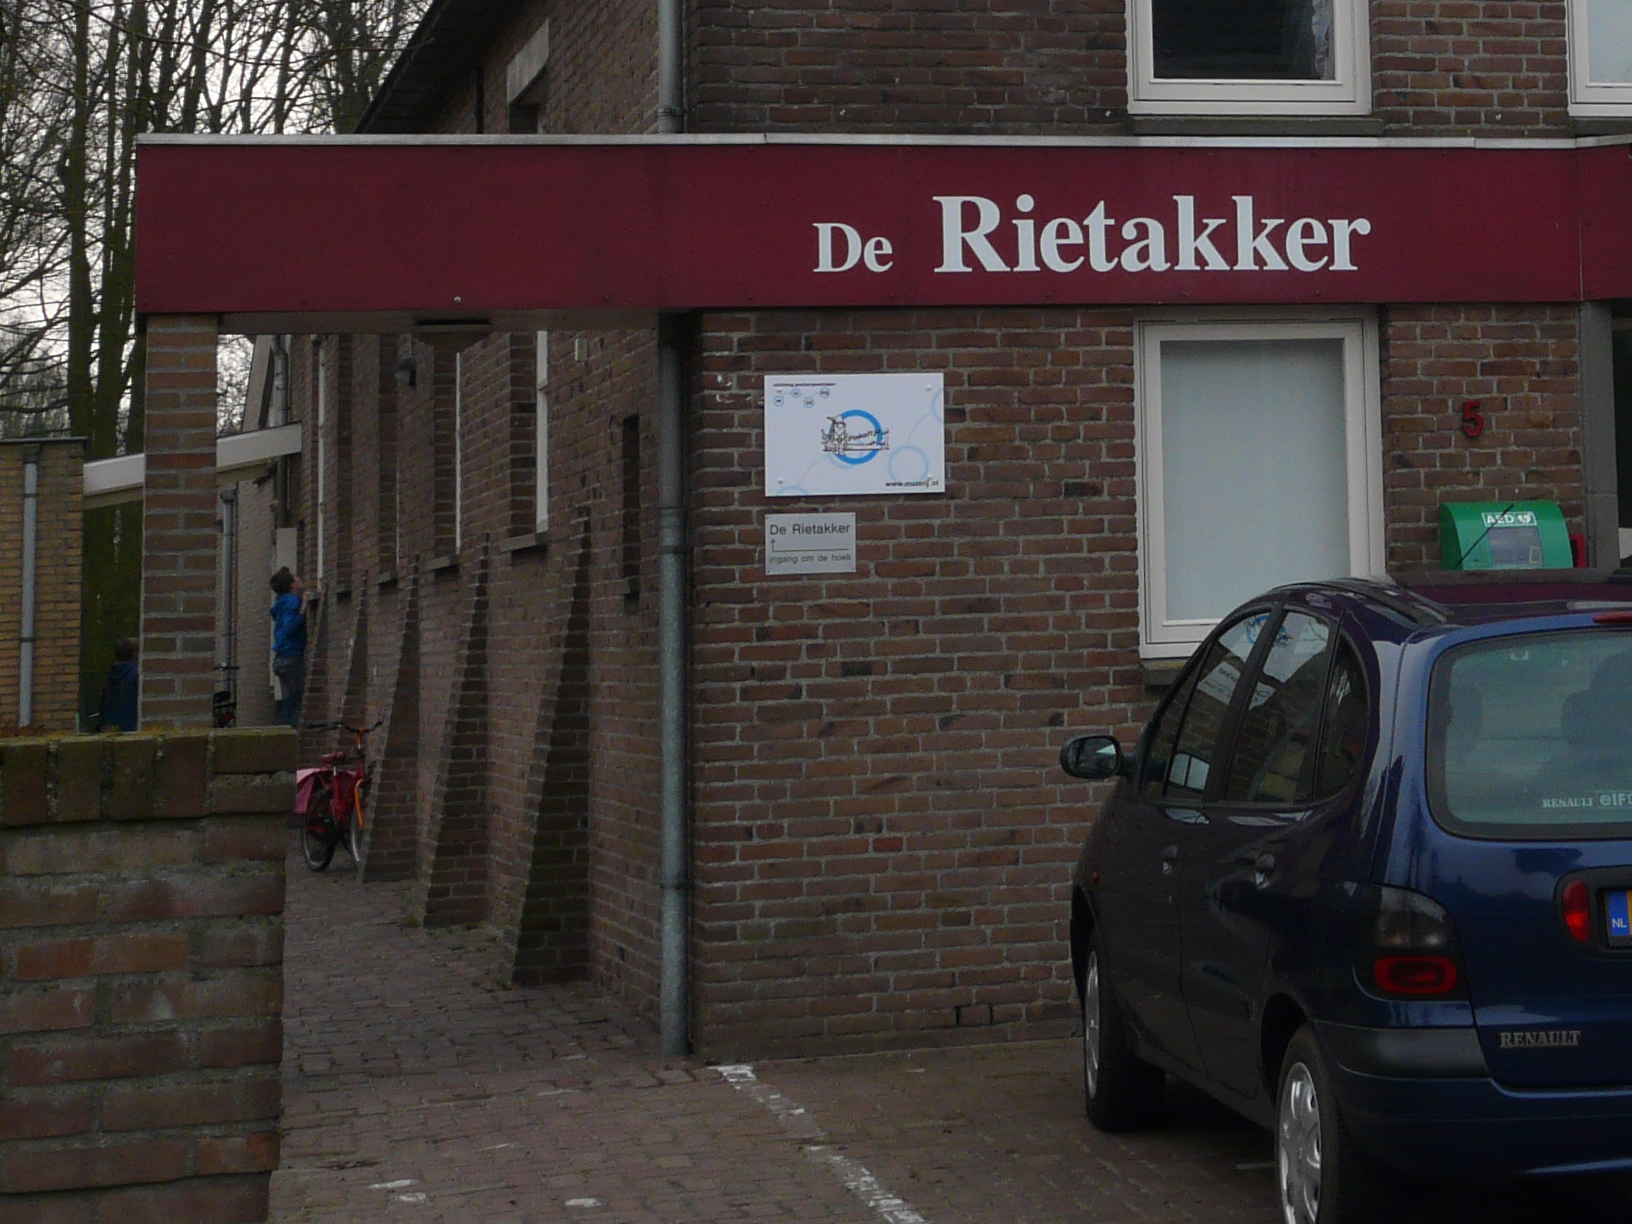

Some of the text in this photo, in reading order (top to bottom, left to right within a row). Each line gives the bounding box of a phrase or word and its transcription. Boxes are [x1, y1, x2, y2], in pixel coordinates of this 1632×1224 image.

[811, 193, 1372, 273] De Rietakker
[1462, 401, 1484, 437] 5
[1486, 513, 1515, 526] AED
[770, 523, 851, 536] De Rietakker
[769, 552, 852, 565] ingang om de hoek
[1542, 797, 1595, 808] RENAULT
[1611, 917, 1627, 929] NL
[1499, 1030, 1581, 1049] RENAULT
